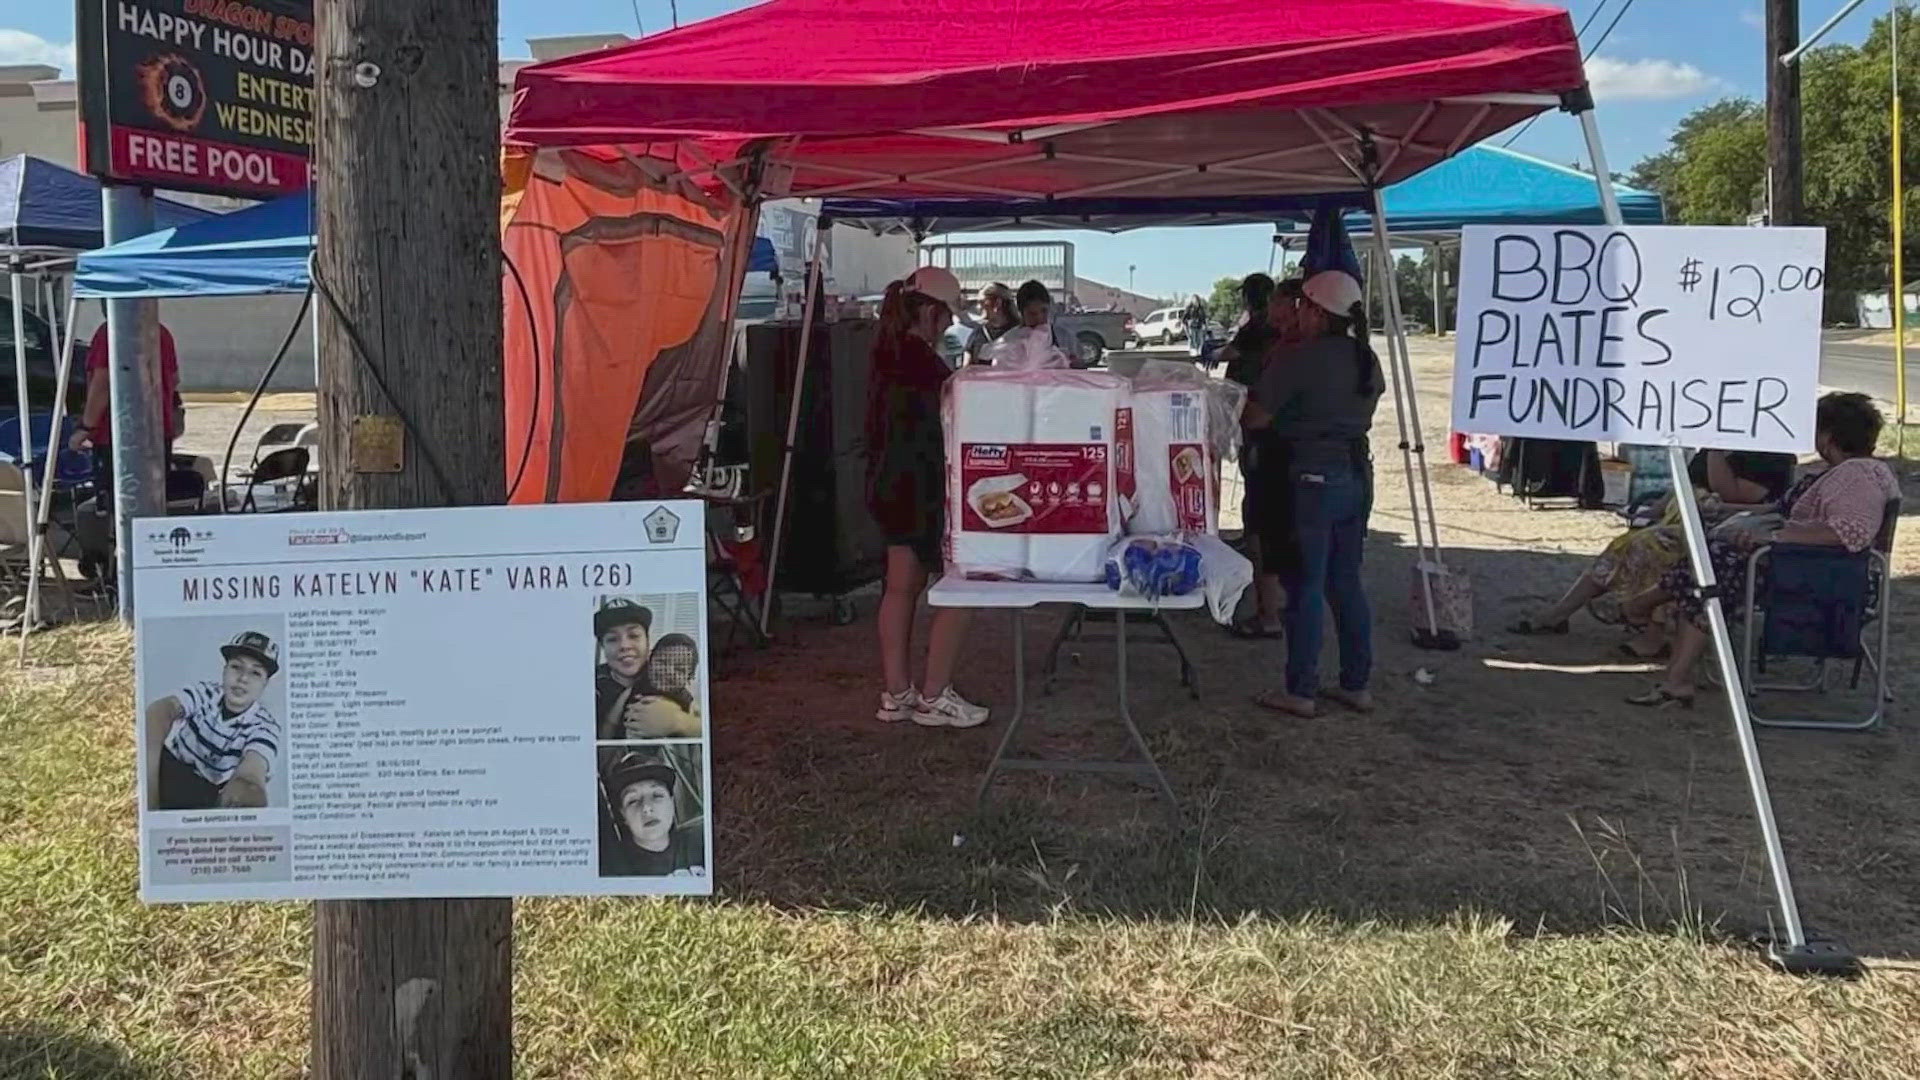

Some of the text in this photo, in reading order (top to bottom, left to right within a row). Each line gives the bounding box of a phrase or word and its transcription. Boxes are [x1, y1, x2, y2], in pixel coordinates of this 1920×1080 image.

[118, 2, 206, 49] HAPPY
[213, 28, 283, 71] HOUR
[183, 0, 315, 46] DRAGON SPO
[175, 82, 185, 99] 8
[128, 134, 199, 175] FREE
[207, 147, 280, 185] POOL
[1492, 230, 1825, 323] BBQ $12.00
[1473, 307, 1672, 369] PLATES
[1469, 374, 1796, 439] FUNDRAISER
[1082, 446, 1106, 460] 125
[183, 563, 633, 601] MISSING KATELYN "KATE" VARA (26)
